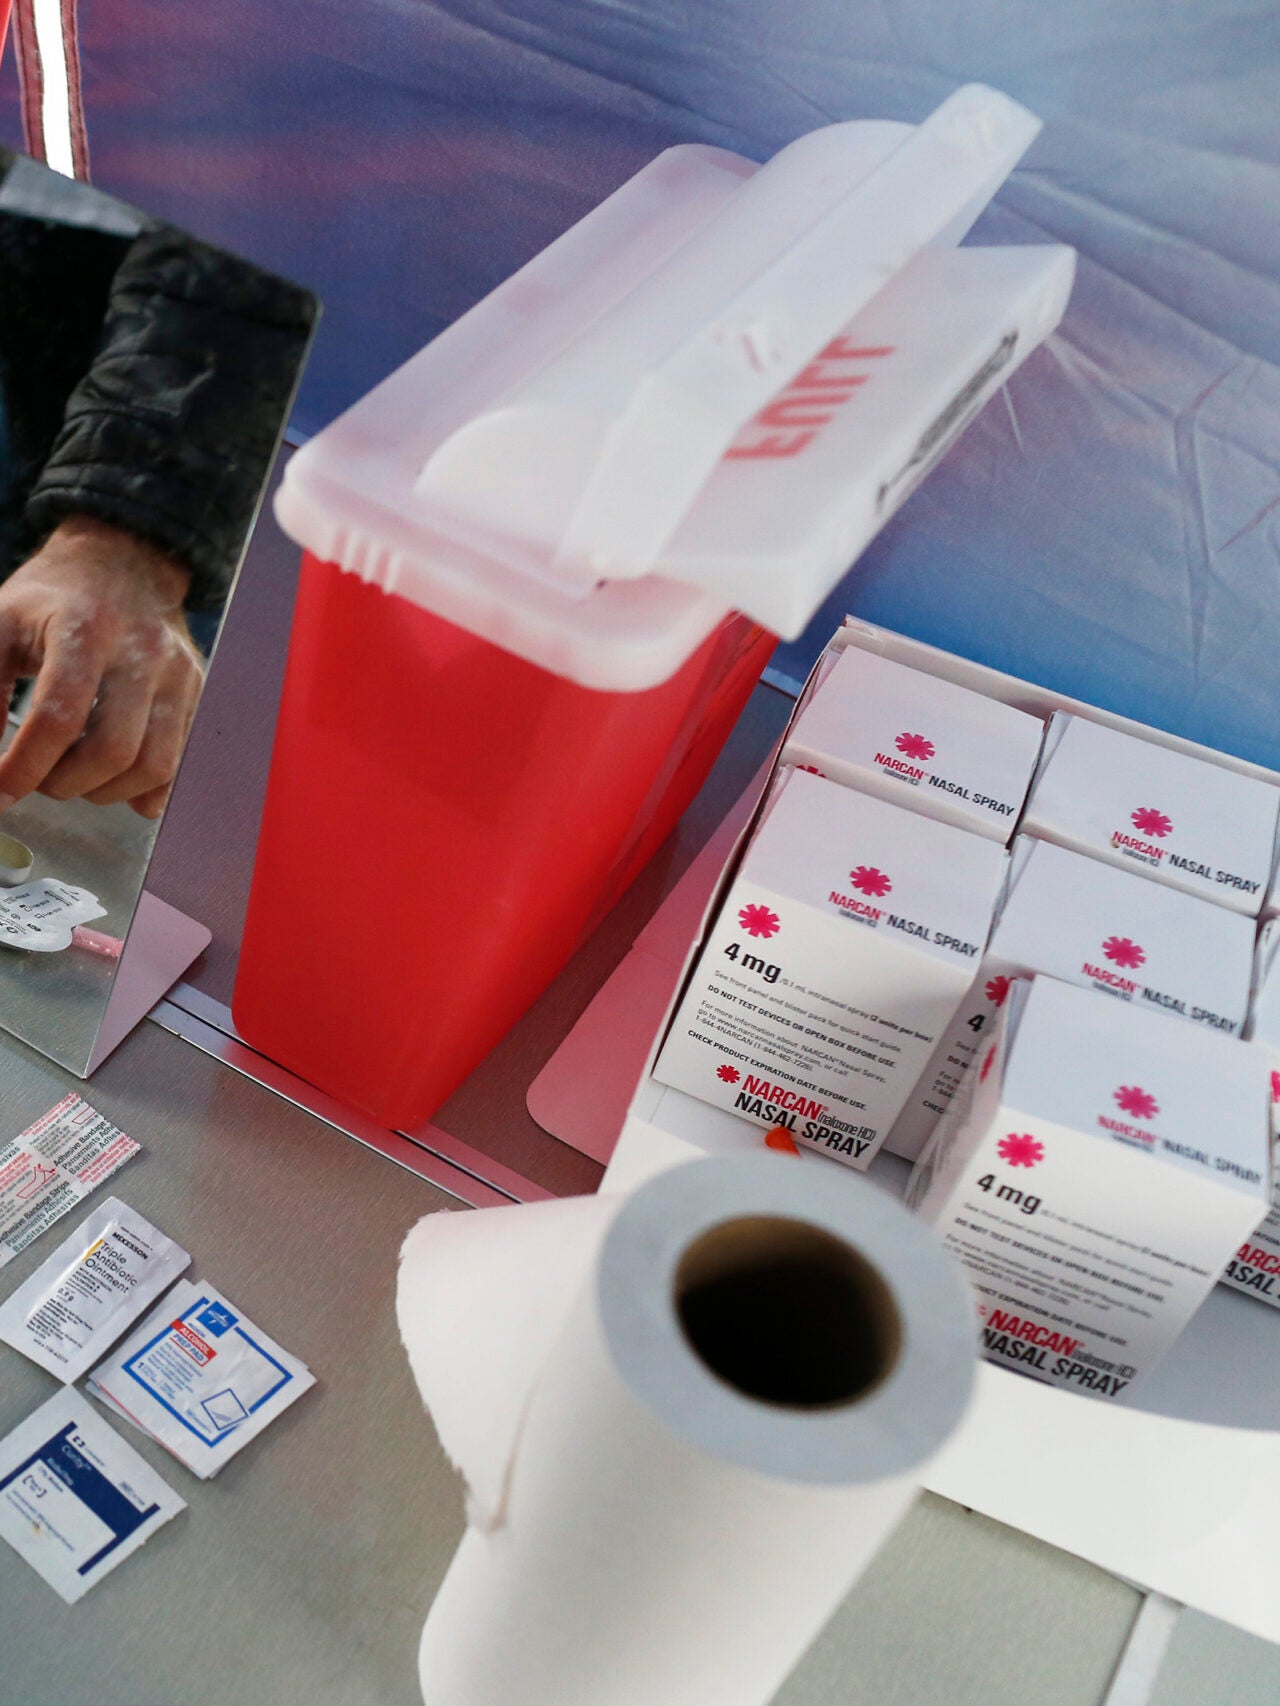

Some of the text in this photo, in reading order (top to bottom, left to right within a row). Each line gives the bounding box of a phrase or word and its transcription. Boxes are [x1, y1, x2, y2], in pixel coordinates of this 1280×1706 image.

[874, 753, 1014, 816] NARCAN NASAL SPRAY
[1170, 854, 1211, 879] NASAL
[1216, 871, 1260, 894] SPRAY
[829, 892, 978, 956] NARCAN NASAL SPRAY
[724, 943, 740, 961] 4
[742, 954, 781, 983] mg
[701, 1000, 713, 1009] For
[714, 1008, 733, 1019] more
[734, 1018, 775, 1038] information
[776, 1036, 798, 1048] about
[708, 985, 895, 1067] DO NOT TEST DEVICES OR OPEN BOX BEFORE USE.
[967, 1014, 986, 1032] 4
[1143, 988, 1185, 1014] NASAL
[1192, 1007, 1236, 1032] SPRAY
[688, 1030, 866, 1110] CHECK PRODUCT EXPIRATION DATE BEFORE USE.
[735, 1093, 868, 1157] NASAL SPRAY
[817, 1109, 858, 1135] (naloxone
[53, 1121, 106, 1166] Adhesive Bandage
[61, 1137, 100, 1169] Pansements
[68, 1149, 100, 1174] Banditas
[24, 1196, 51, 1219] Bandage
[49, 1181, 69, 1198] Strips
[978, 1174, 1040, 1215] 4 mg
[5, 1213, 45, 1247] Pansements
[12, 1195, 79, 1252] Banditas Adhesivas
[89, 1251, 137, 1286] Antibiotic
[101, 1242, 127, 1264] Triple
[85, 1258, 132, 1293] Ointment
[173, 1334, 204, 1361] PREP PAD
[180, 1328, 209, 1354] ALCOHOL
[988, 1309, 1077, 1356] NARCAN
[981, 1328, 1049, 1370] NASAL
[1052, 1358, 1128, 1397] SPRAY
